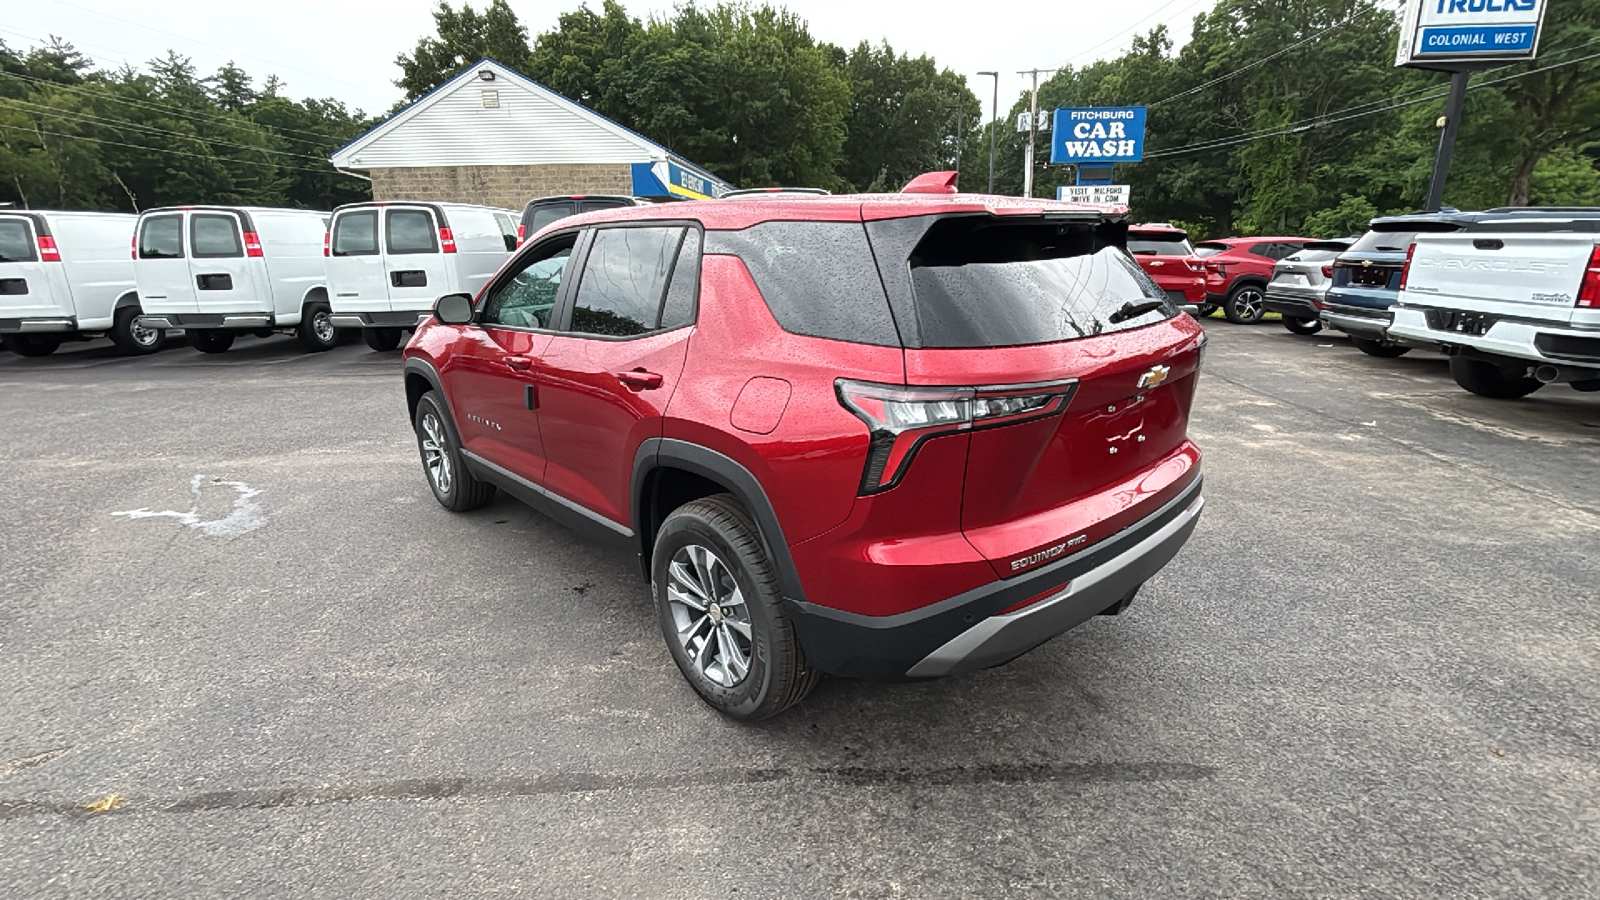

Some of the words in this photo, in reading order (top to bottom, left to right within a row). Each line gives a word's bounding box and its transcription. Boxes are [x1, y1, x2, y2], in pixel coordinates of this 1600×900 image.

[1428, 33, 1487, 46] COLONIAL
[1494, 32, 1527, 44] WEST
[1071, 111, 1134, 120] FITCHBURG
[1074, 122, 1126, 138] CAR
[1065, 140, 1135, 157] WASH
[1070, 187, 1088, 195] VISIT
[1094, 187, 1122, 195] MILFORD
[1418, 257, 1569, 273] CHEVROLET
[1011, 543, 1066, 570] EQUINOX
